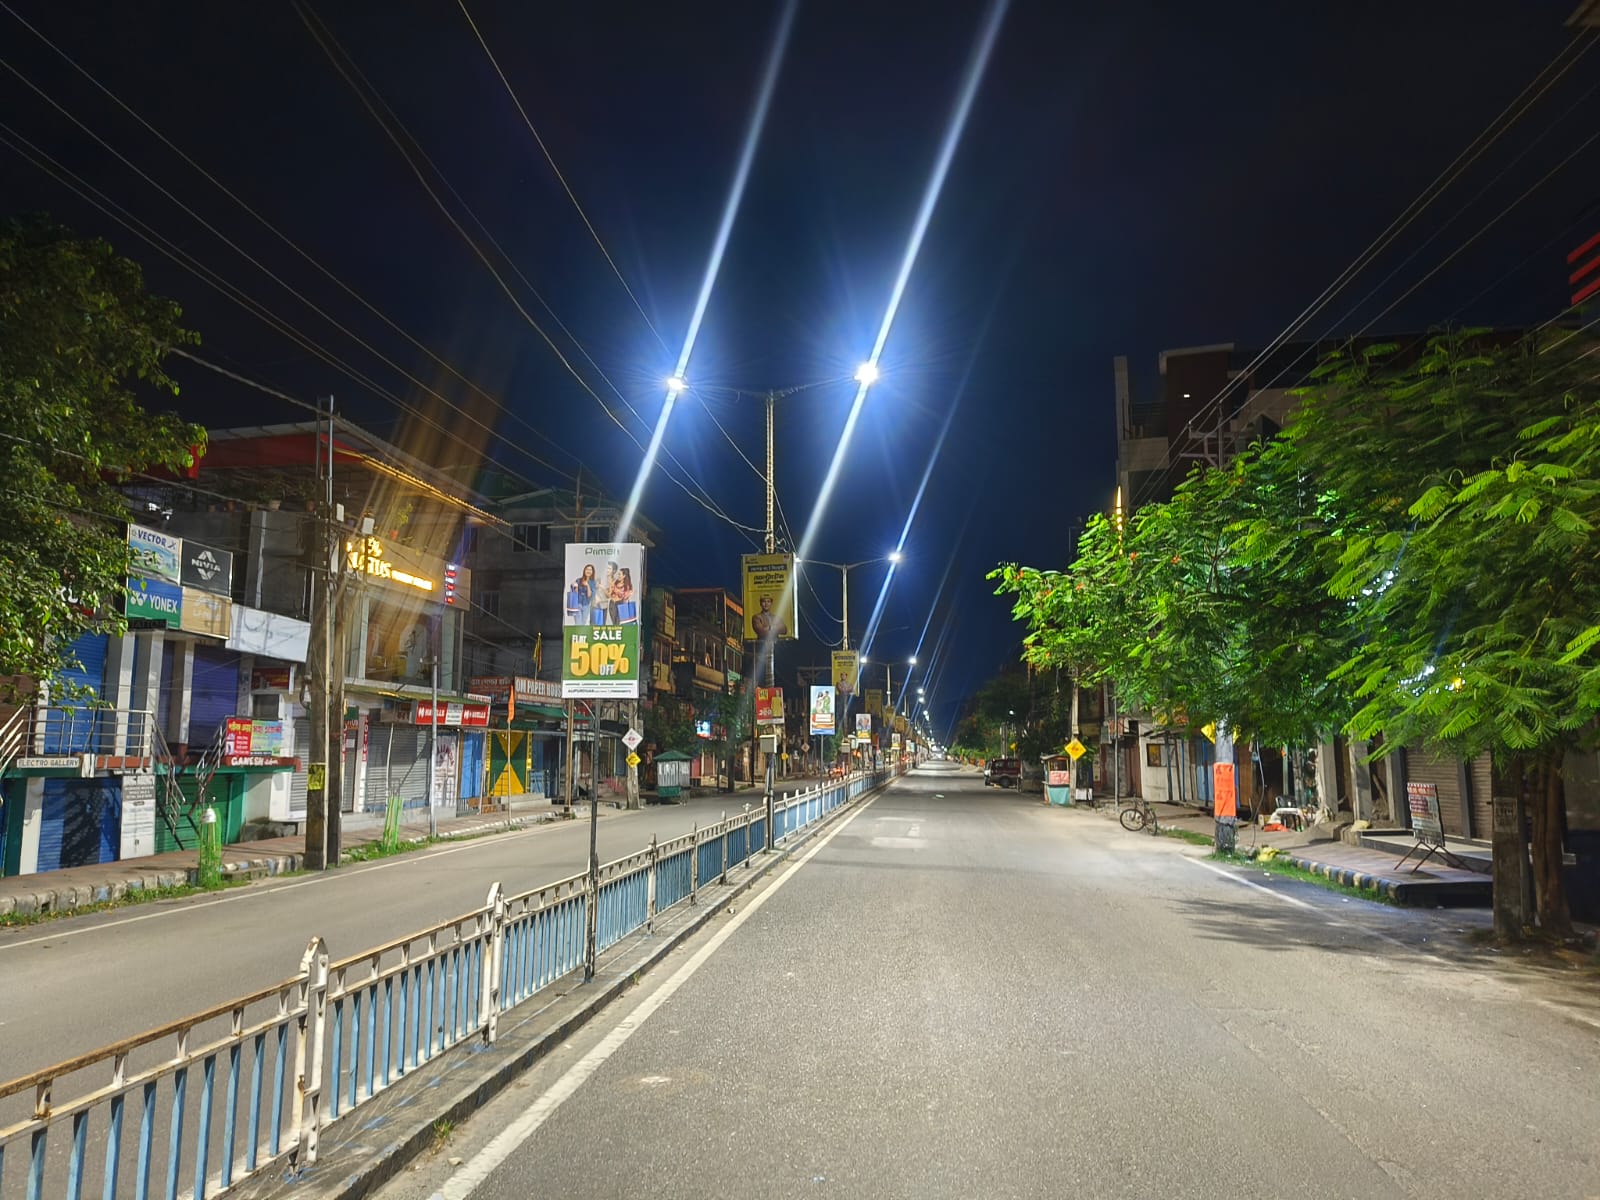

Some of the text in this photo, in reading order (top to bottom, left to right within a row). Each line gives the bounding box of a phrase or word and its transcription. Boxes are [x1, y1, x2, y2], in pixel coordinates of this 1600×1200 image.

[137, 529, 167, 548] VECTOR
[191, 558, 221, 572] NIVIA
[149, 594, 178, 614] YONEX
[572, 634, 587, 644] FLAT
[593, 630, 622, 641] SALE
[570, 642, 629, 676] 50%
[600, 664, 616, 676] OFF
[527, 680, 546, 695] PAPER
[547, 682, 562, 697] HOUS
[50, 759, 79, 767] GALLERY
[231, 756, 264, 766] GANESH
